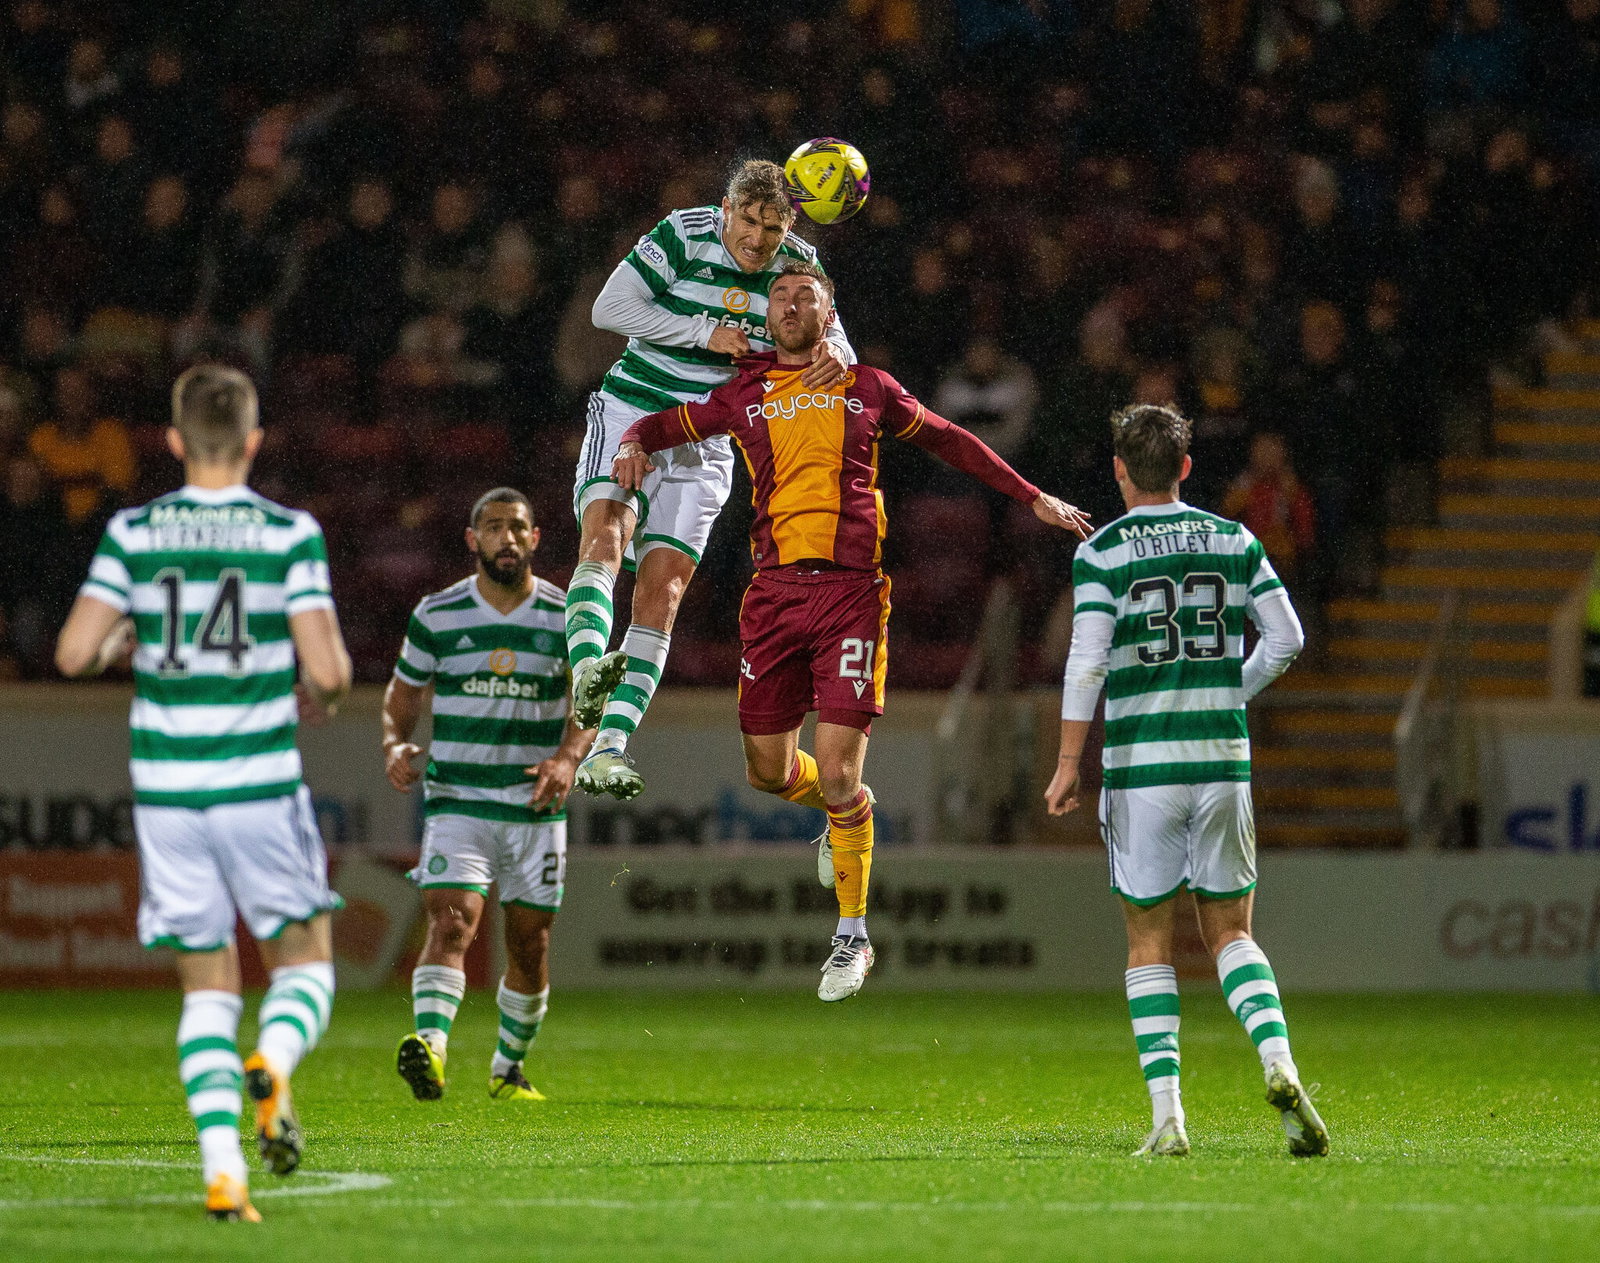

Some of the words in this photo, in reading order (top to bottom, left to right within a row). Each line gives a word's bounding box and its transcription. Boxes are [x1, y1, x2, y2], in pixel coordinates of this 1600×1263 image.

[745, 393, 864, 428] Paycare
[1118, 519, 1218, 543] MAGNERS
[152, 566, 258, 680] 14
[1128, 571, 1228, 667] 33
[838, 637, 875, 681] 21
